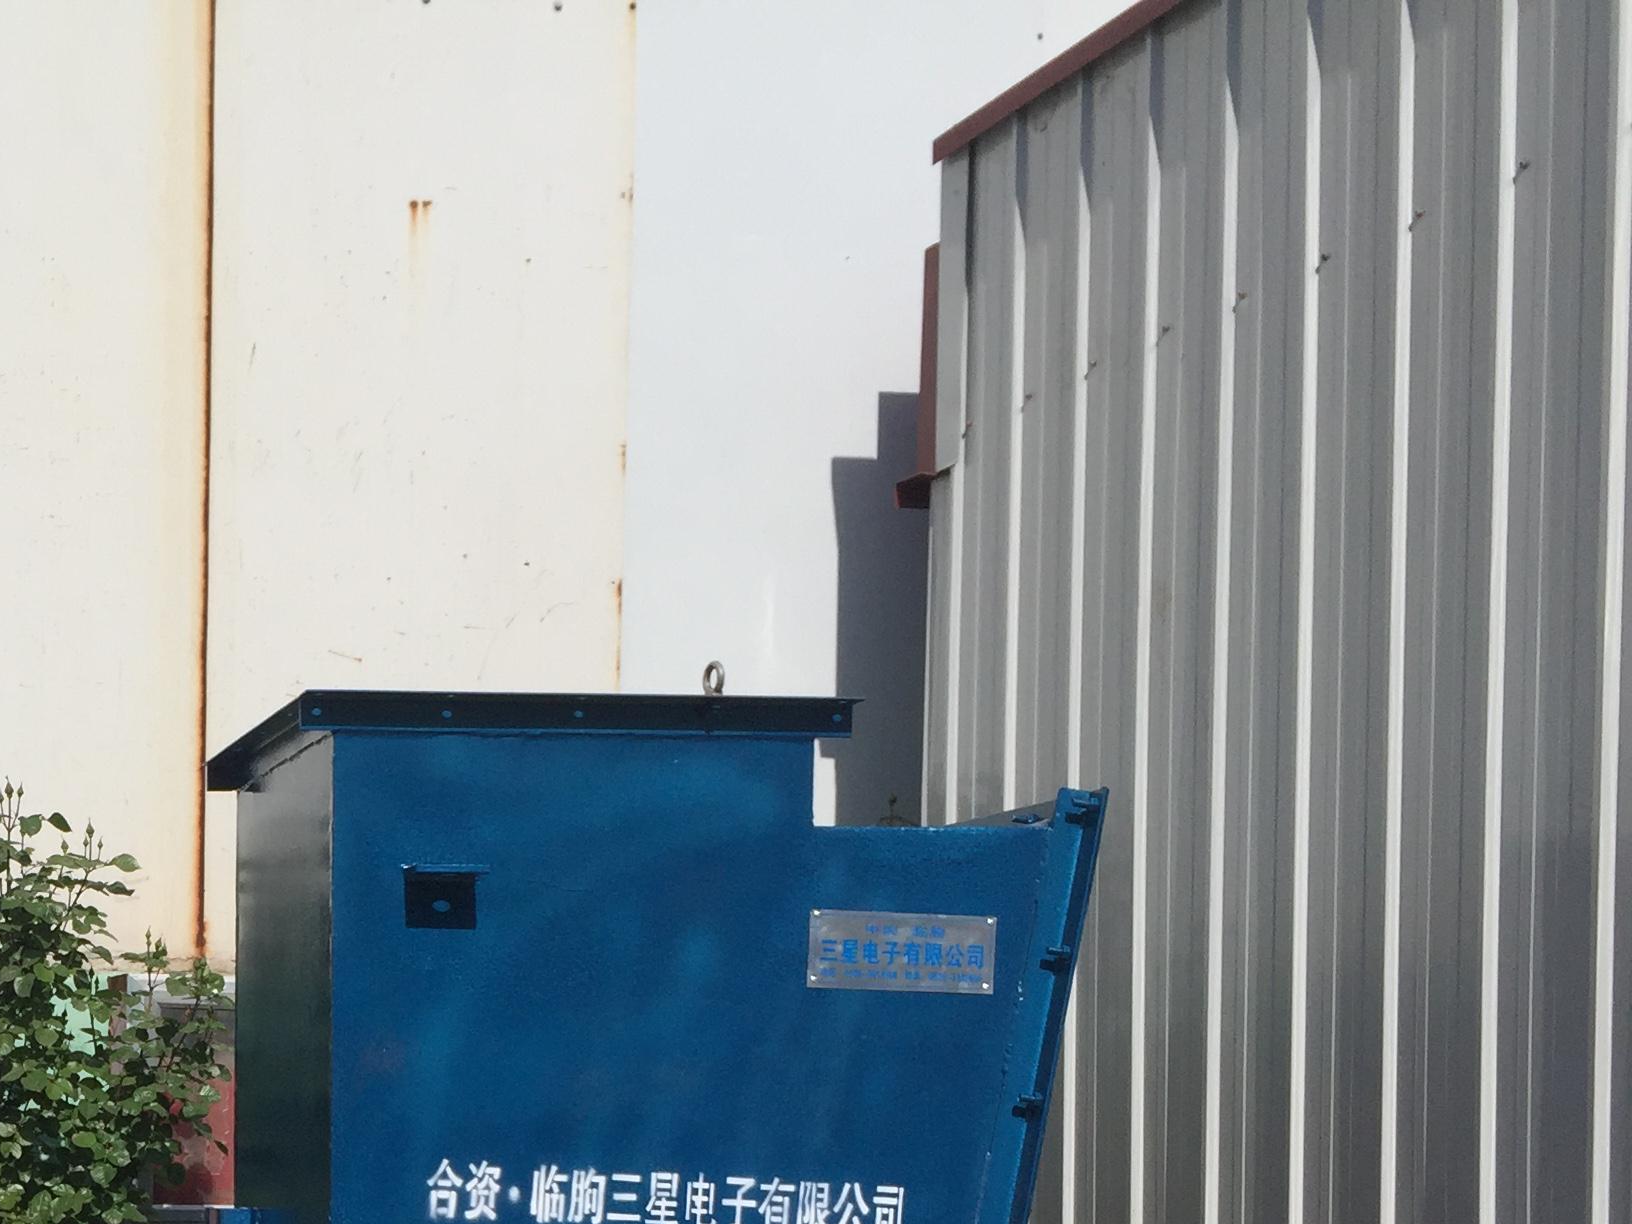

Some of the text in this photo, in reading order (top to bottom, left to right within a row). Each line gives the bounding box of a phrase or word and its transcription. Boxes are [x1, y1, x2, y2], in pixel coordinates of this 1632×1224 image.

[820, 938, 985, 969] 三星电子有限公司
